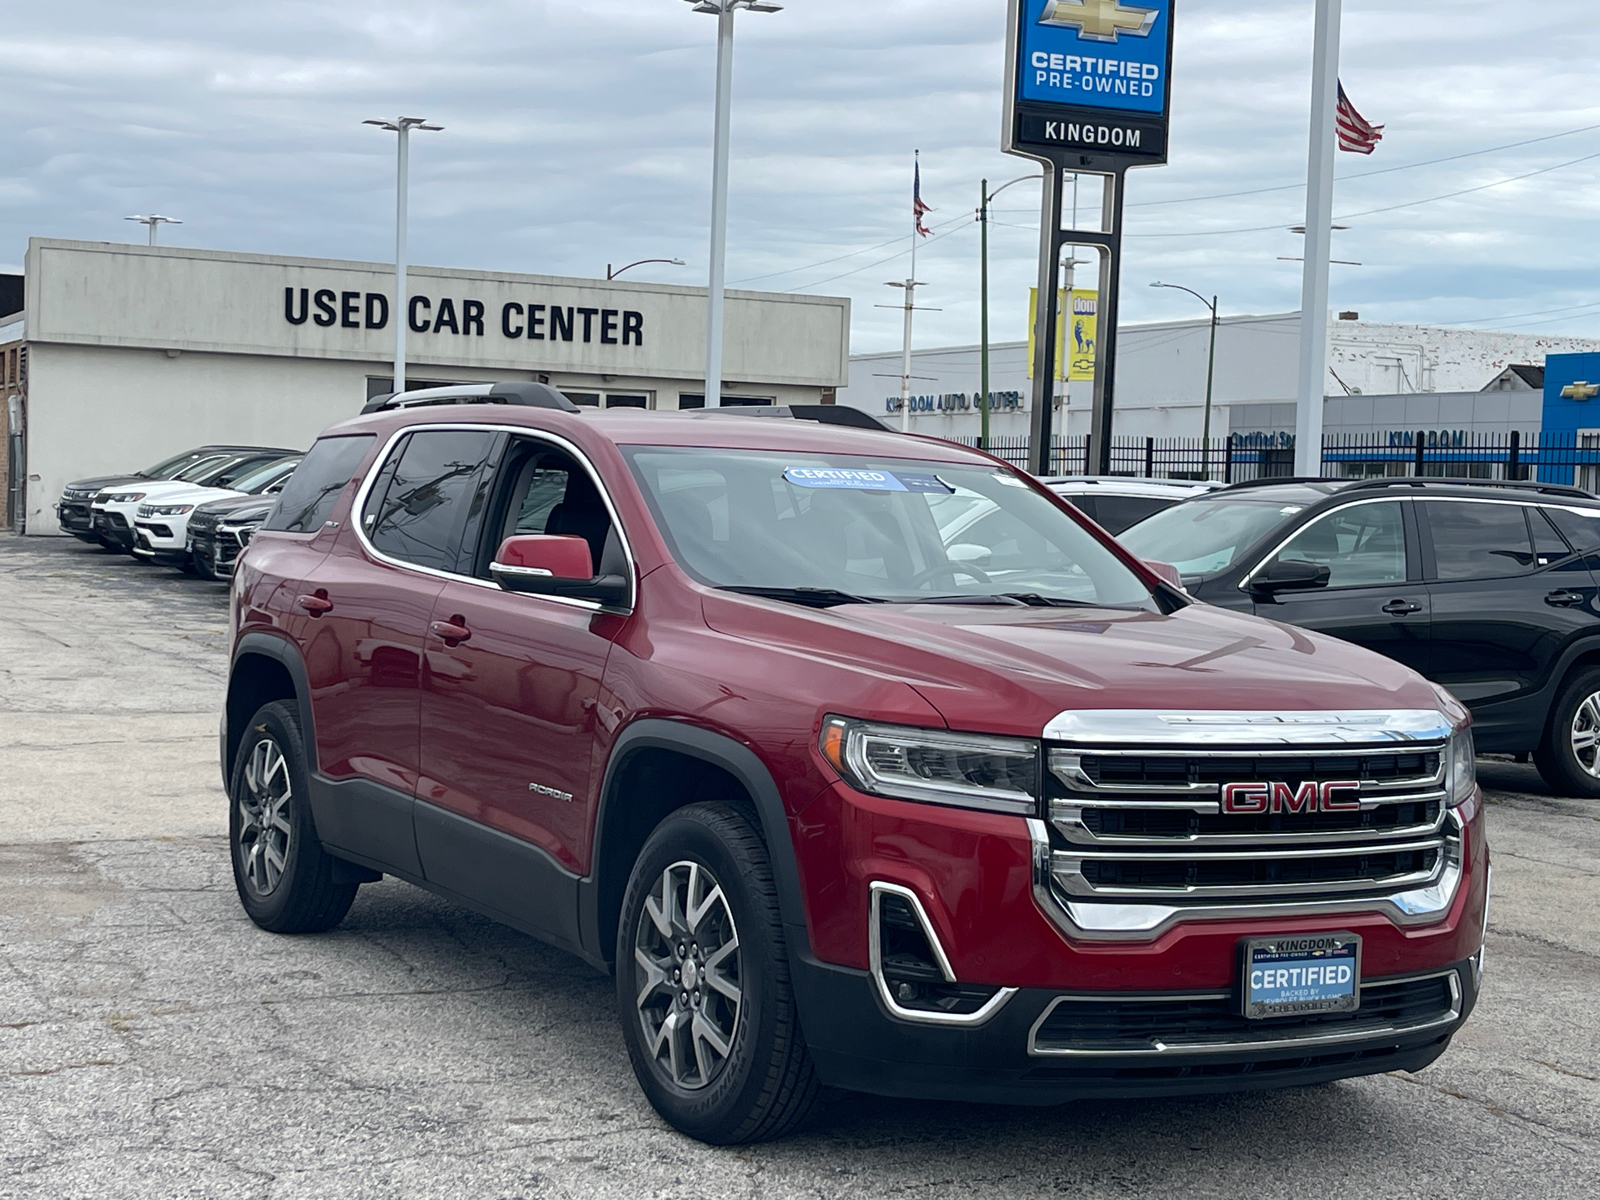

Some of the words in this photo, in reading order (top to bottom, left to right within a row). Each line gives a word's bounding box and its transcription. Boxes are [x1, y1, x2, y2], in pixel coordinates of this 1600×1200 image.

[1031, 51, 1159, 80] CERTIFIED
[1036, 70, 1153, 97] PRE-OWNED
[1045, 121, 1140, 147] KINGDOM
[285, 286, 389, 330] USED
[408, 295, 485, 336] CAR
[501, 302, 644, 347] CENTER
[973, 391, 1021, 409] CNTER
[1389, 429, 1464, 447] KINDOM
[790, 469, 886, 482] CERTIFIED
[1222, 781, 1360, 814] GMC
[1277, 938, 1335, 951] KINGDOM
[1250, 965, 1351, 990] CERTIFIED
[1280, 989, 1309, 998] BACKED
[1310, 988, 1320, 996] BY
[1273, 1001, 1332, 1014] CHEVROLET
